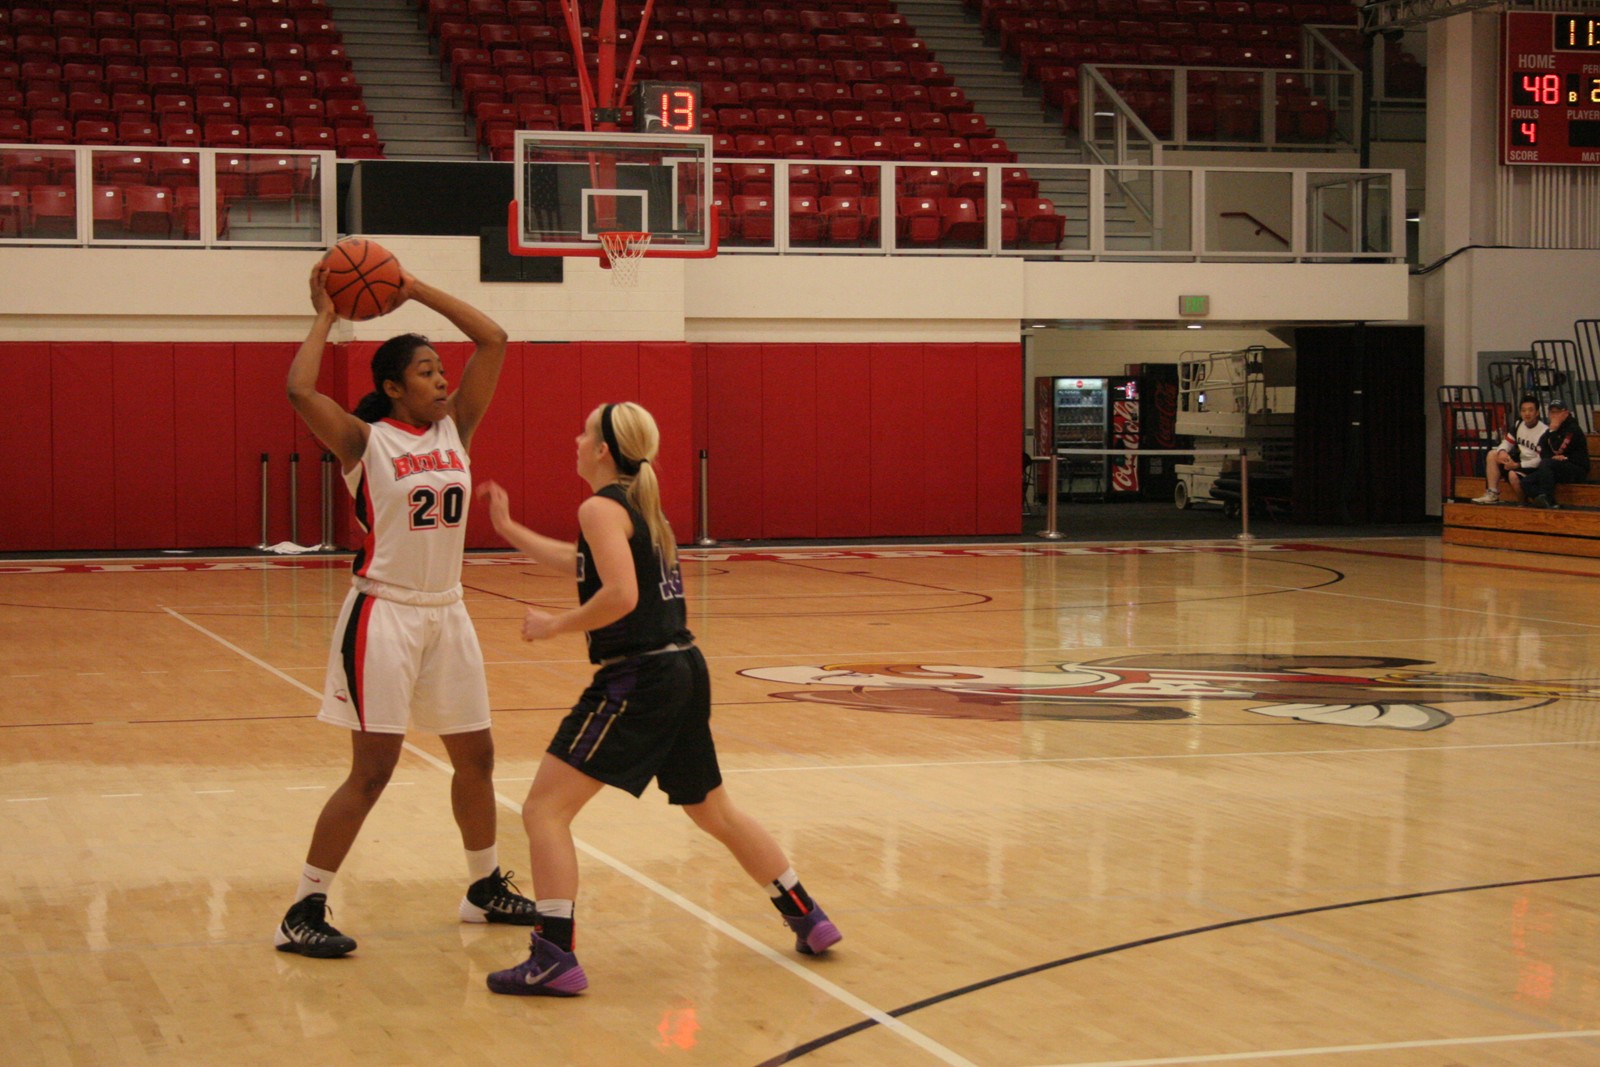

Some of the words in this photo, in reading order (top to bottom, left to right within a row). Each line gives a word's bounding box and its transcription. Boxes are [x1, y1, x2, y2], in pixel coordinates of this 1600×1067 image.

[1518, 54, 1556, 69] HOME
[1522, 74, 1561, 105] 48
[661, 91, 695, 131] 13
[1510, 108, 1539, 119] FOULS
[1520, 122, 1537, 143] 4
[1510, 150, 1539, 161] SCORE
[408, 482, 466, 531] 20
